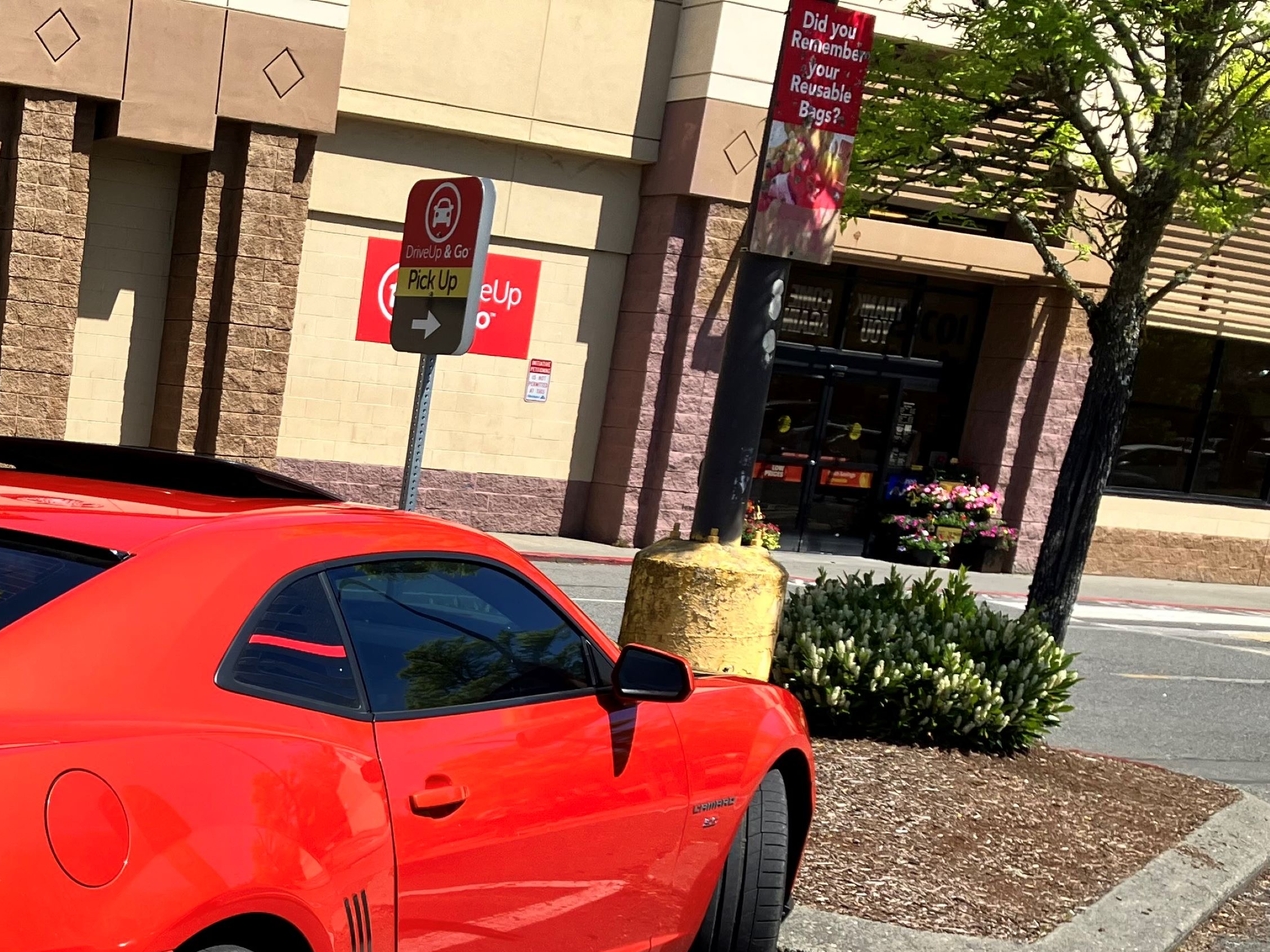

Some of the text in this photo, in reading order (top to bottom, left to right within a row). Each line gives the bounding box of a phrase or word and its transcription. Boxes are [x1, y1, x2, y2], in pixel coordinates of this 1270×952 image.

[803, 10, 857, 40] Did you
[791, 30, 865, 63] Remember
[806, 60, 840, 80] your
[790, 74, 852, 104] Reusable
[799, 100, 841, 126] Bags?
[406, 244, 442, 261] DriveUp
[444, 245, 451, 258] &
[408, 268, 458, 295] Pick Up
